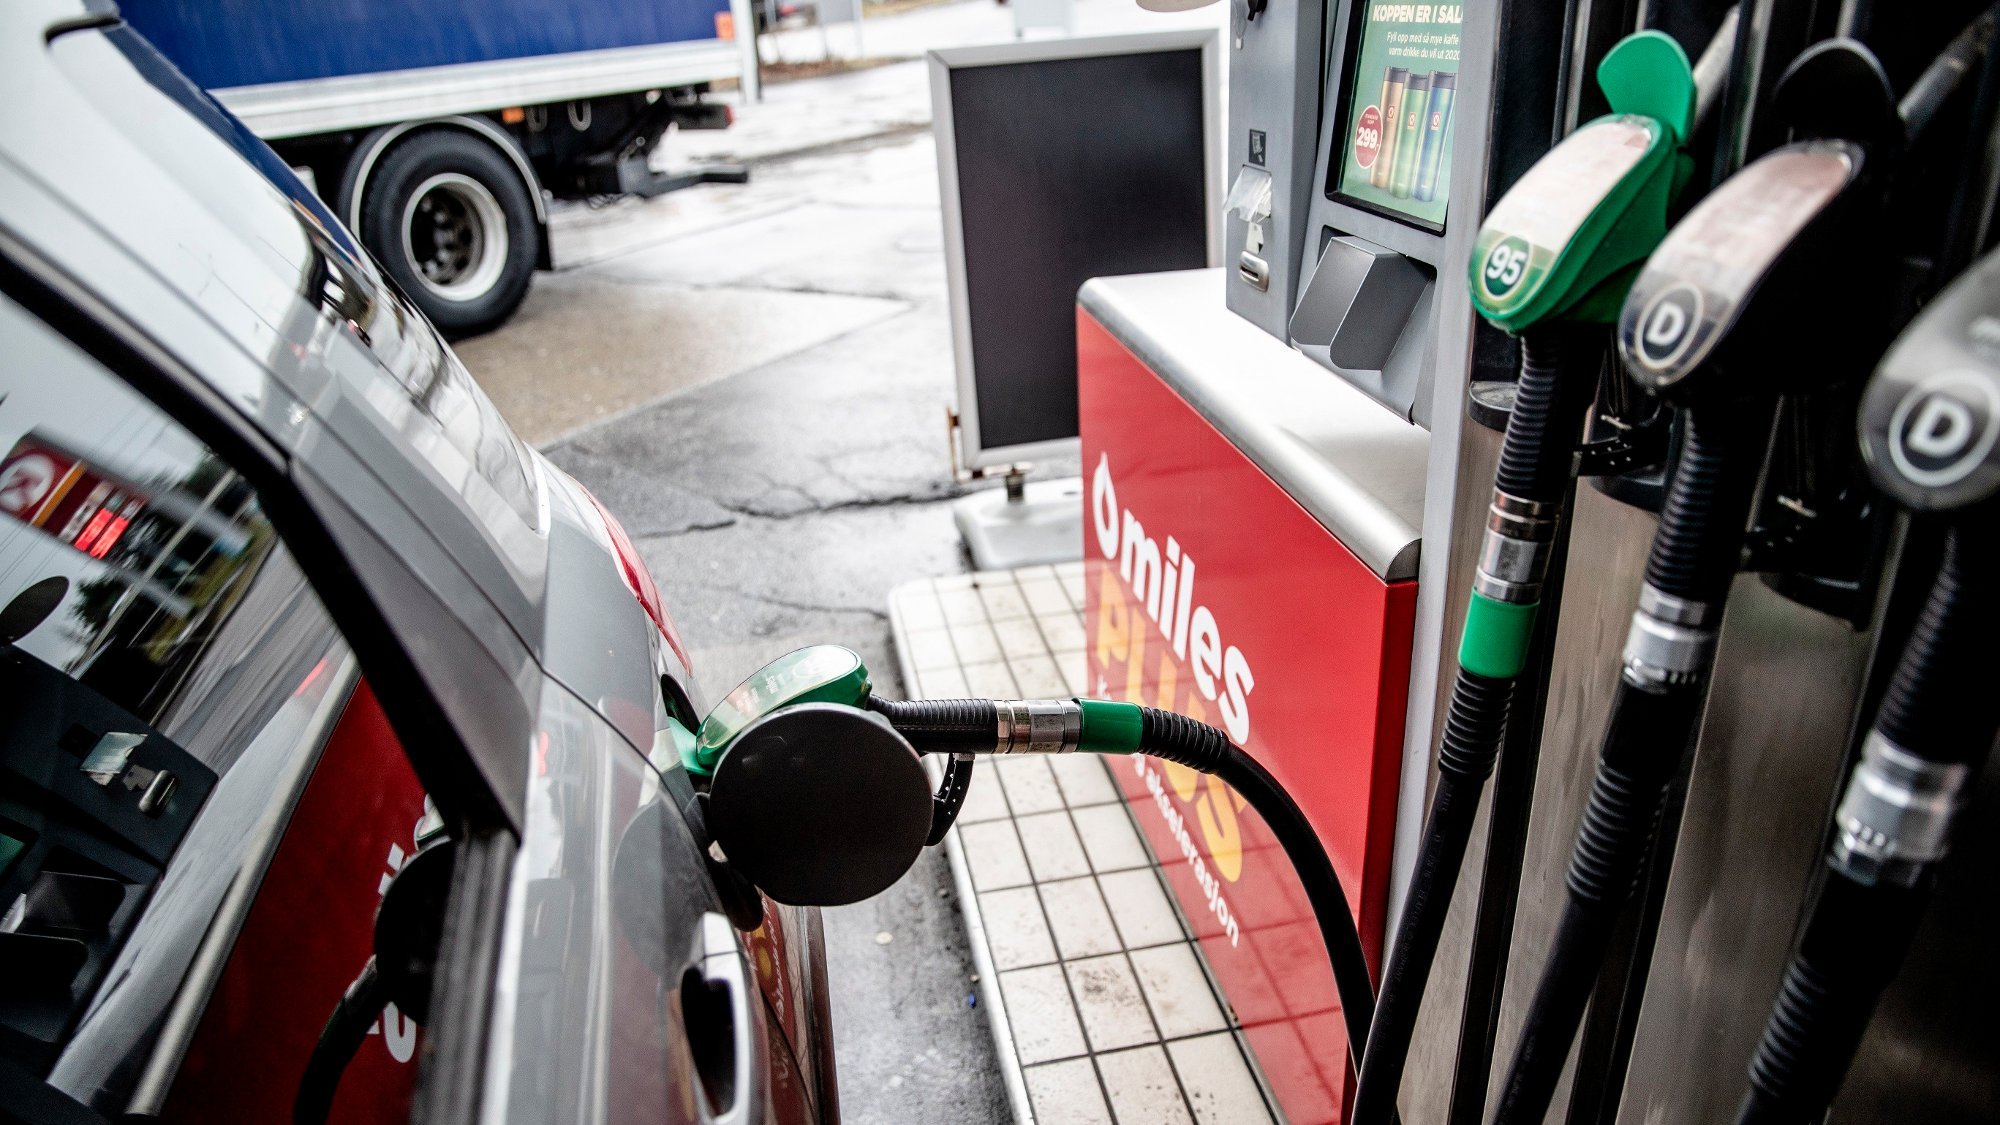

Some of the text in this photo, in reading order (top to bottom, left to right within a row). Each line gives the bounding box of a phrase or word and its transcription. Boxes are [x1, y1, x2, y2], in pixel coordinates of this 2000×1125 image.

[1373, 5, 1415, 22] KOPPEN
[1415, 5, 1432, 23] ER
[1432, 5, 1438, 24] I
[1387, 31, 1459, 46] Fyll opp med så mye kaffe
[1388, 47, 1402, 56] varm
[1402, 46, 1420, 57] drikke
[1420, 47, 1429, 58] du
[1429, 48, 1438, 59] vil
[1437, 49, 1445, 59] ut
[1486, 244, 1527, 286] 95
[1646, 301, 1686, 346] D
[1907, 398, 1973, 457] D
[1146, 767, 1240, 948] akselerasjon
